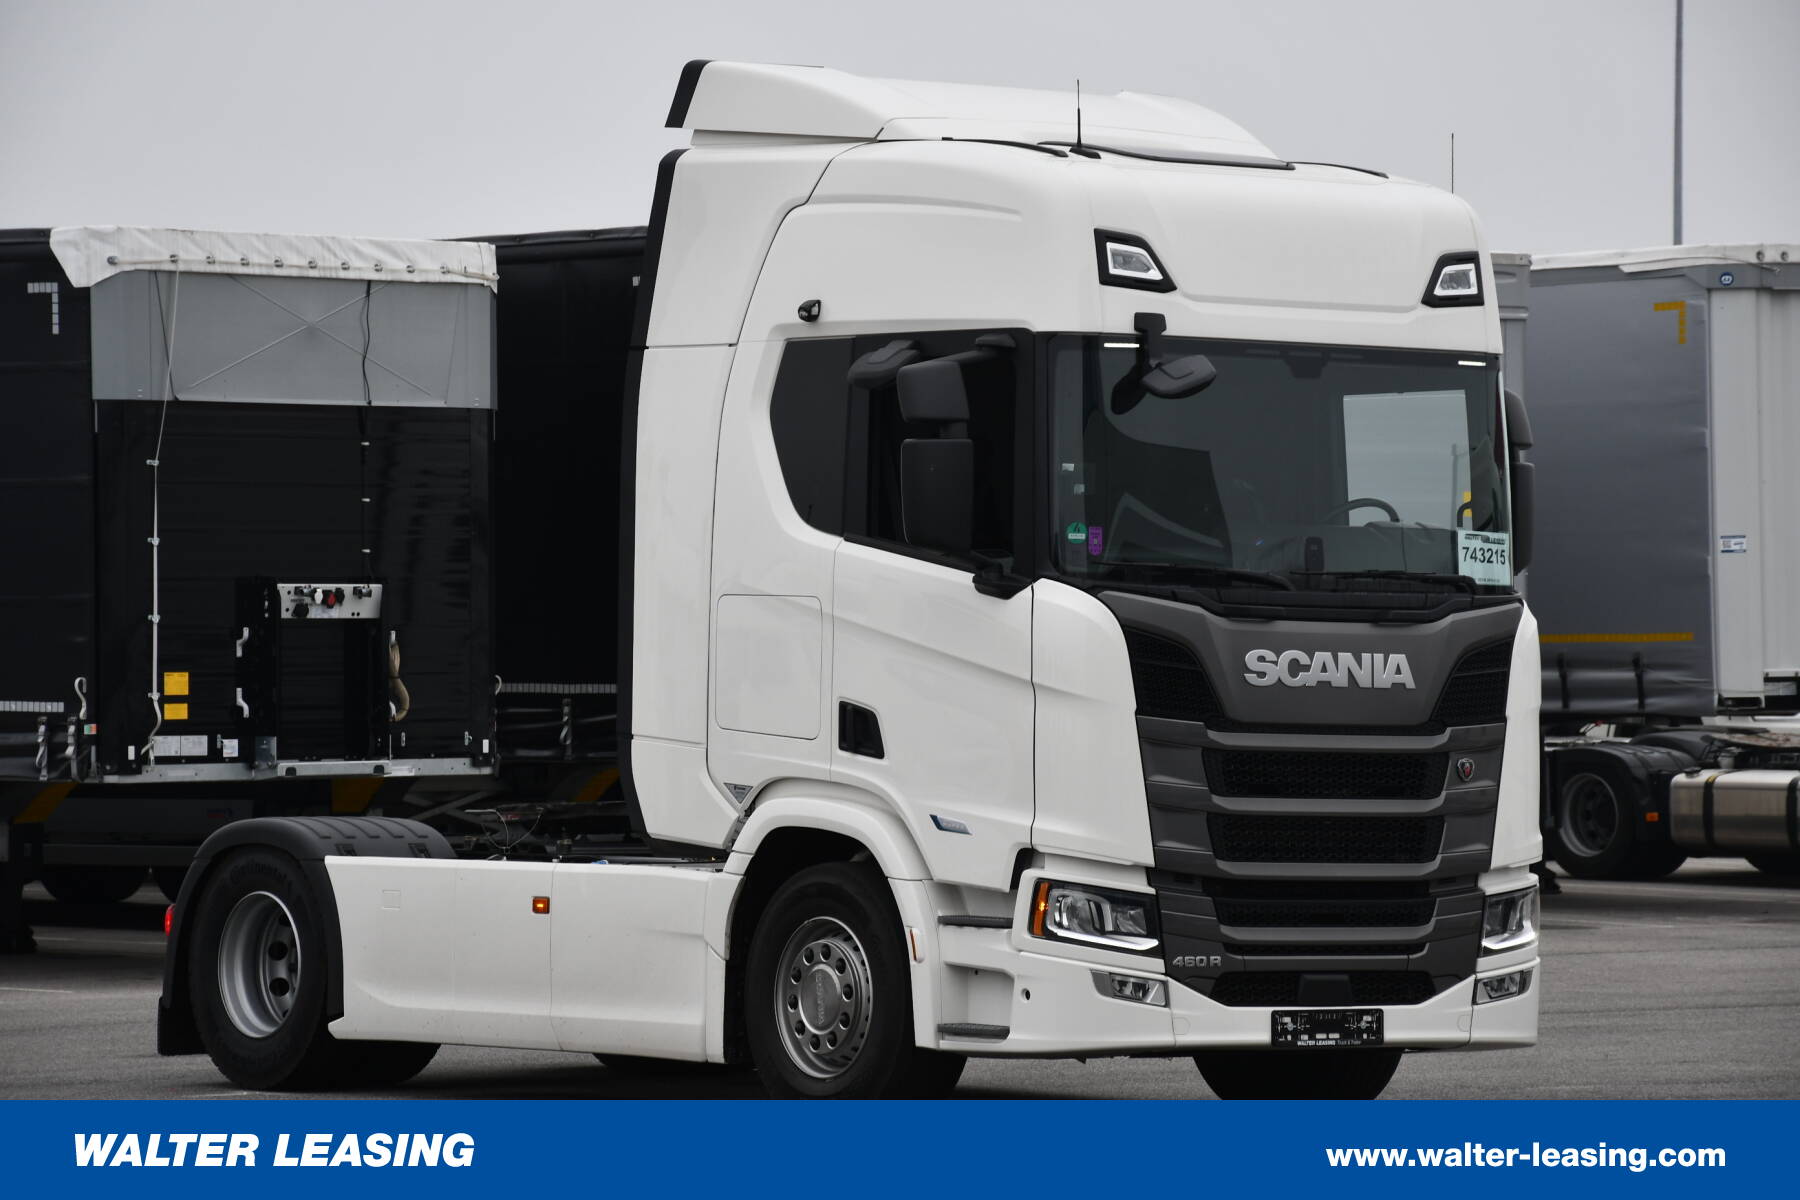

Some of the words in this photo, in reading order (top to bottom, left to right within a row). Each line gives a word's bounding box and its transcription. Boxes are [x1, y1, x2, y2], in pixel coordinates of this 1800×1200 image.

[1462, 546, 1506, 565] 743215
[1244, 649, 1417, 690] SCANIA
[1173, 956, 1207, 968] 460
[1209, 956, 1222, 968] R
